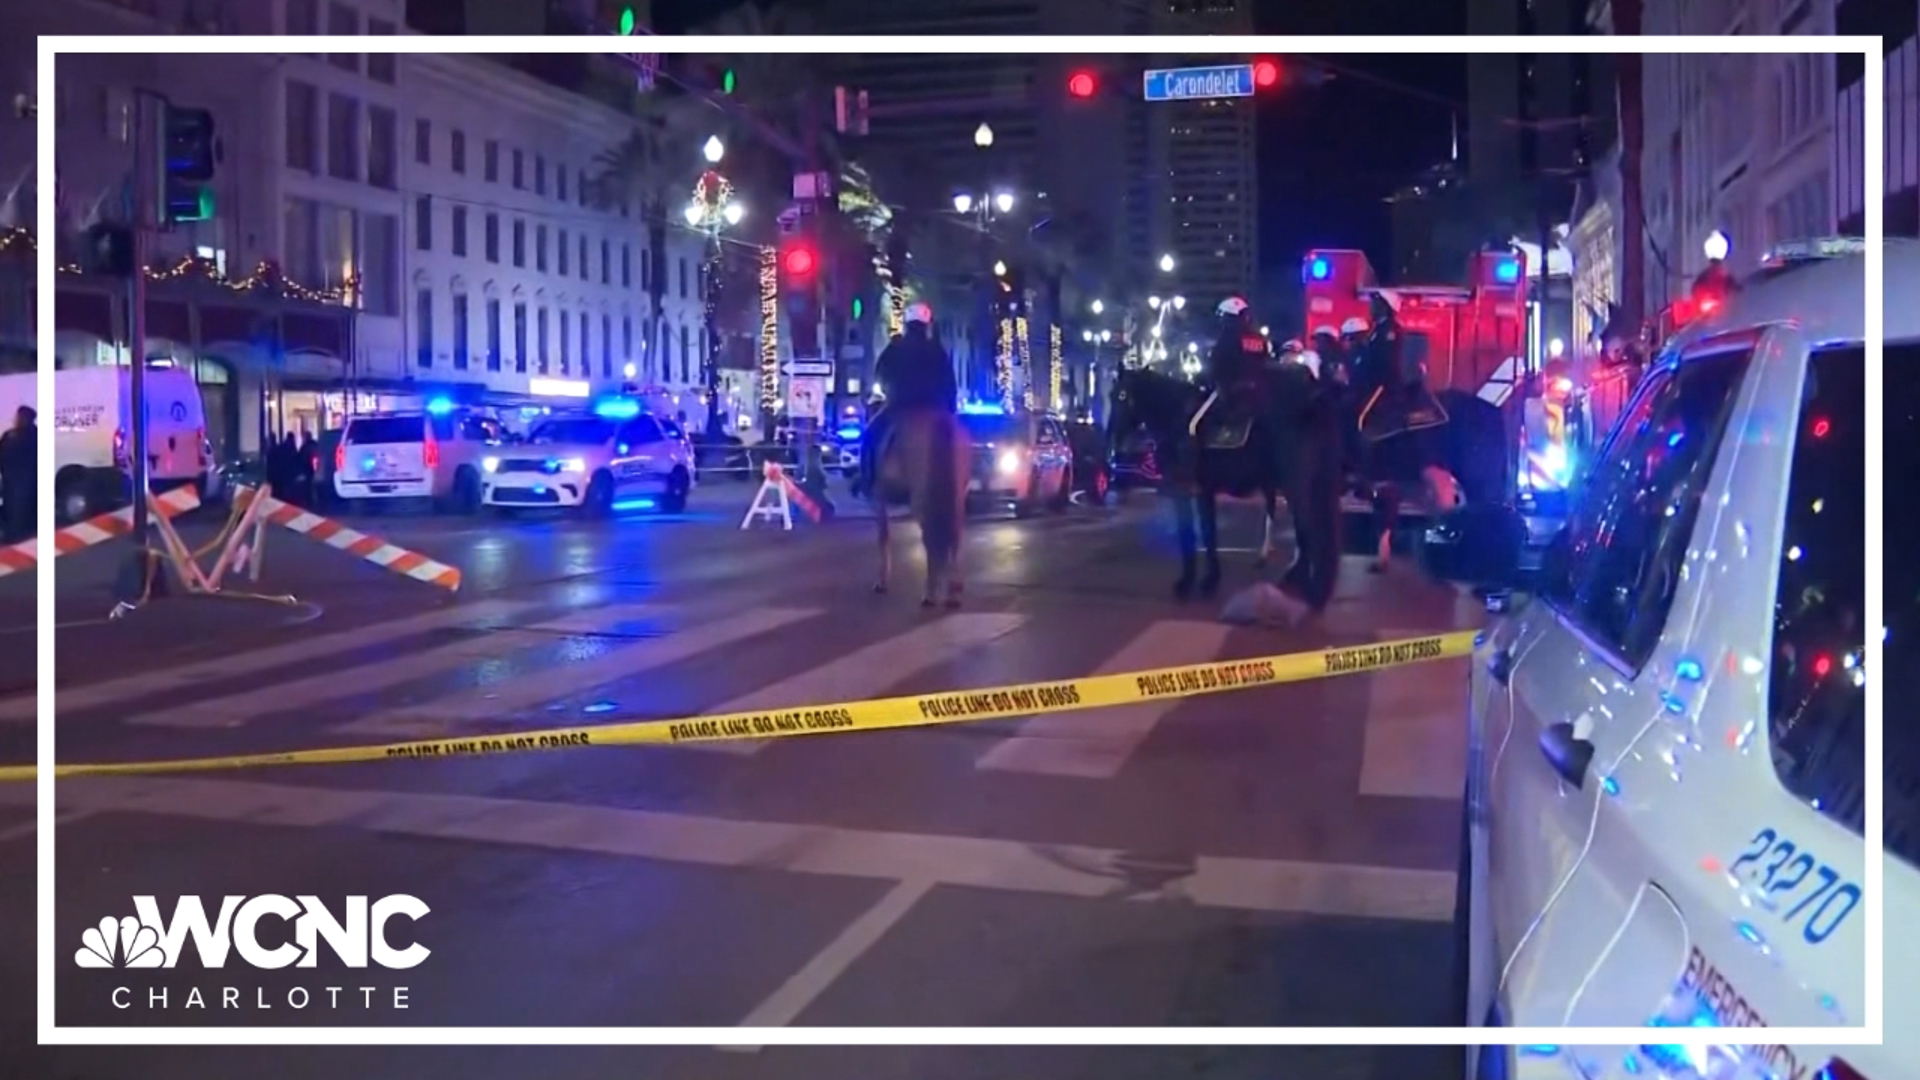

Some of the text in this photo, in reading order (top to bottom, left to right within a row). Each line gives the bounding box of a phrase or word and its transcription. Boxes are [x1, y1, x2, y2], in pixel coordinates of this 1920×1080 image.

[1165, 69, 1240, 97] Carondelet
[1325, 651, 1357, 672] POLICE
[1358, 648, 1378, 667] LINE
[1393, 643, 1410, 661] NOT
[1411, 639, 1441, 659] CROSS
[1137, 661, 1275, 695] POLICE LINE DO NOT CROSS
[918, 684, 1081, 718] POLICE LINE DO NOT CROSS
[670, 721, 717, 740] POLICE
[753, 716, 774, 733] DO
[775, 713, 804, 730] NOT
[804, 708, 853, 728] CROSS
[1729, 827, 1861, 944] 23270
